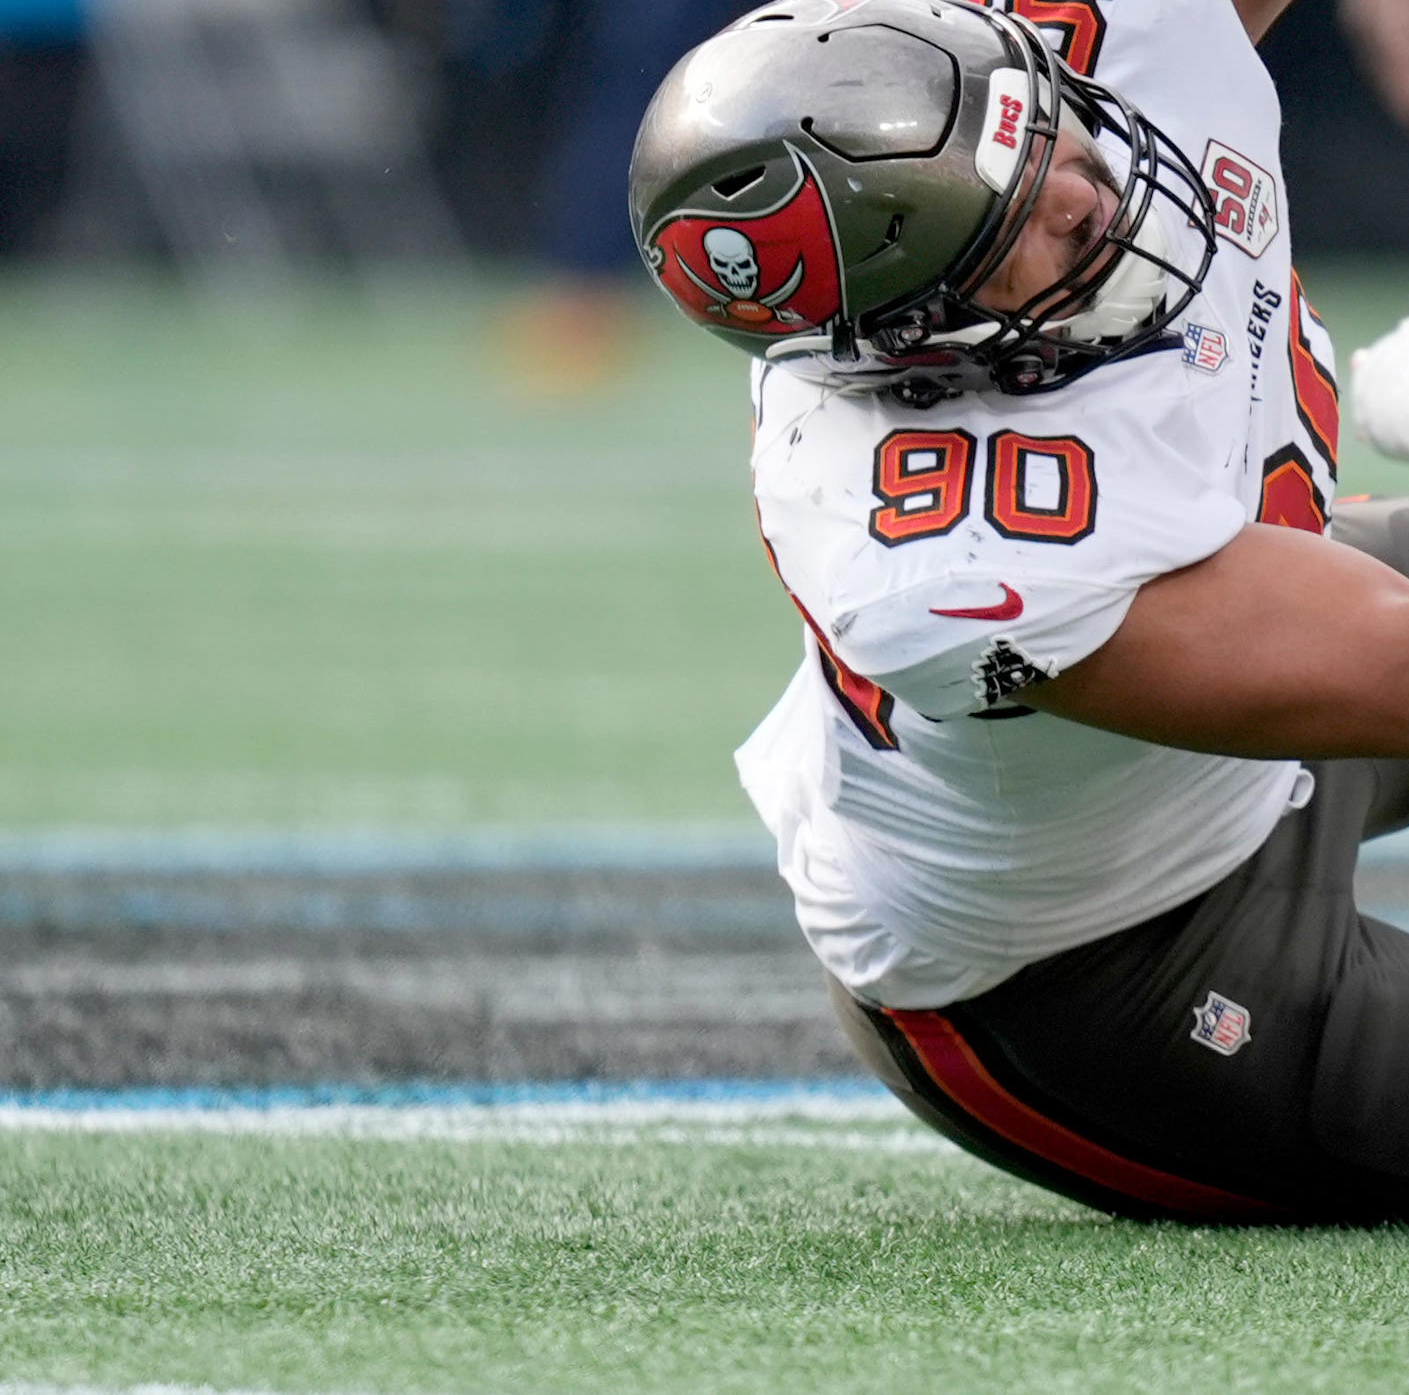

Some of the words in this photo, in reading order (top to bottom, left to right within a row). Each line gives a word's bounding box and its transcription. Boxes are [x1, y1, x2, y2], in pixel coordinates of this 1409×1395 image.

[992, 94, 1024, 150] BUCS
[1210, 156, 1254, 236] 50
[1198, 335, 1223, 368] NFL
[868, 427, 1099, 549] 90
